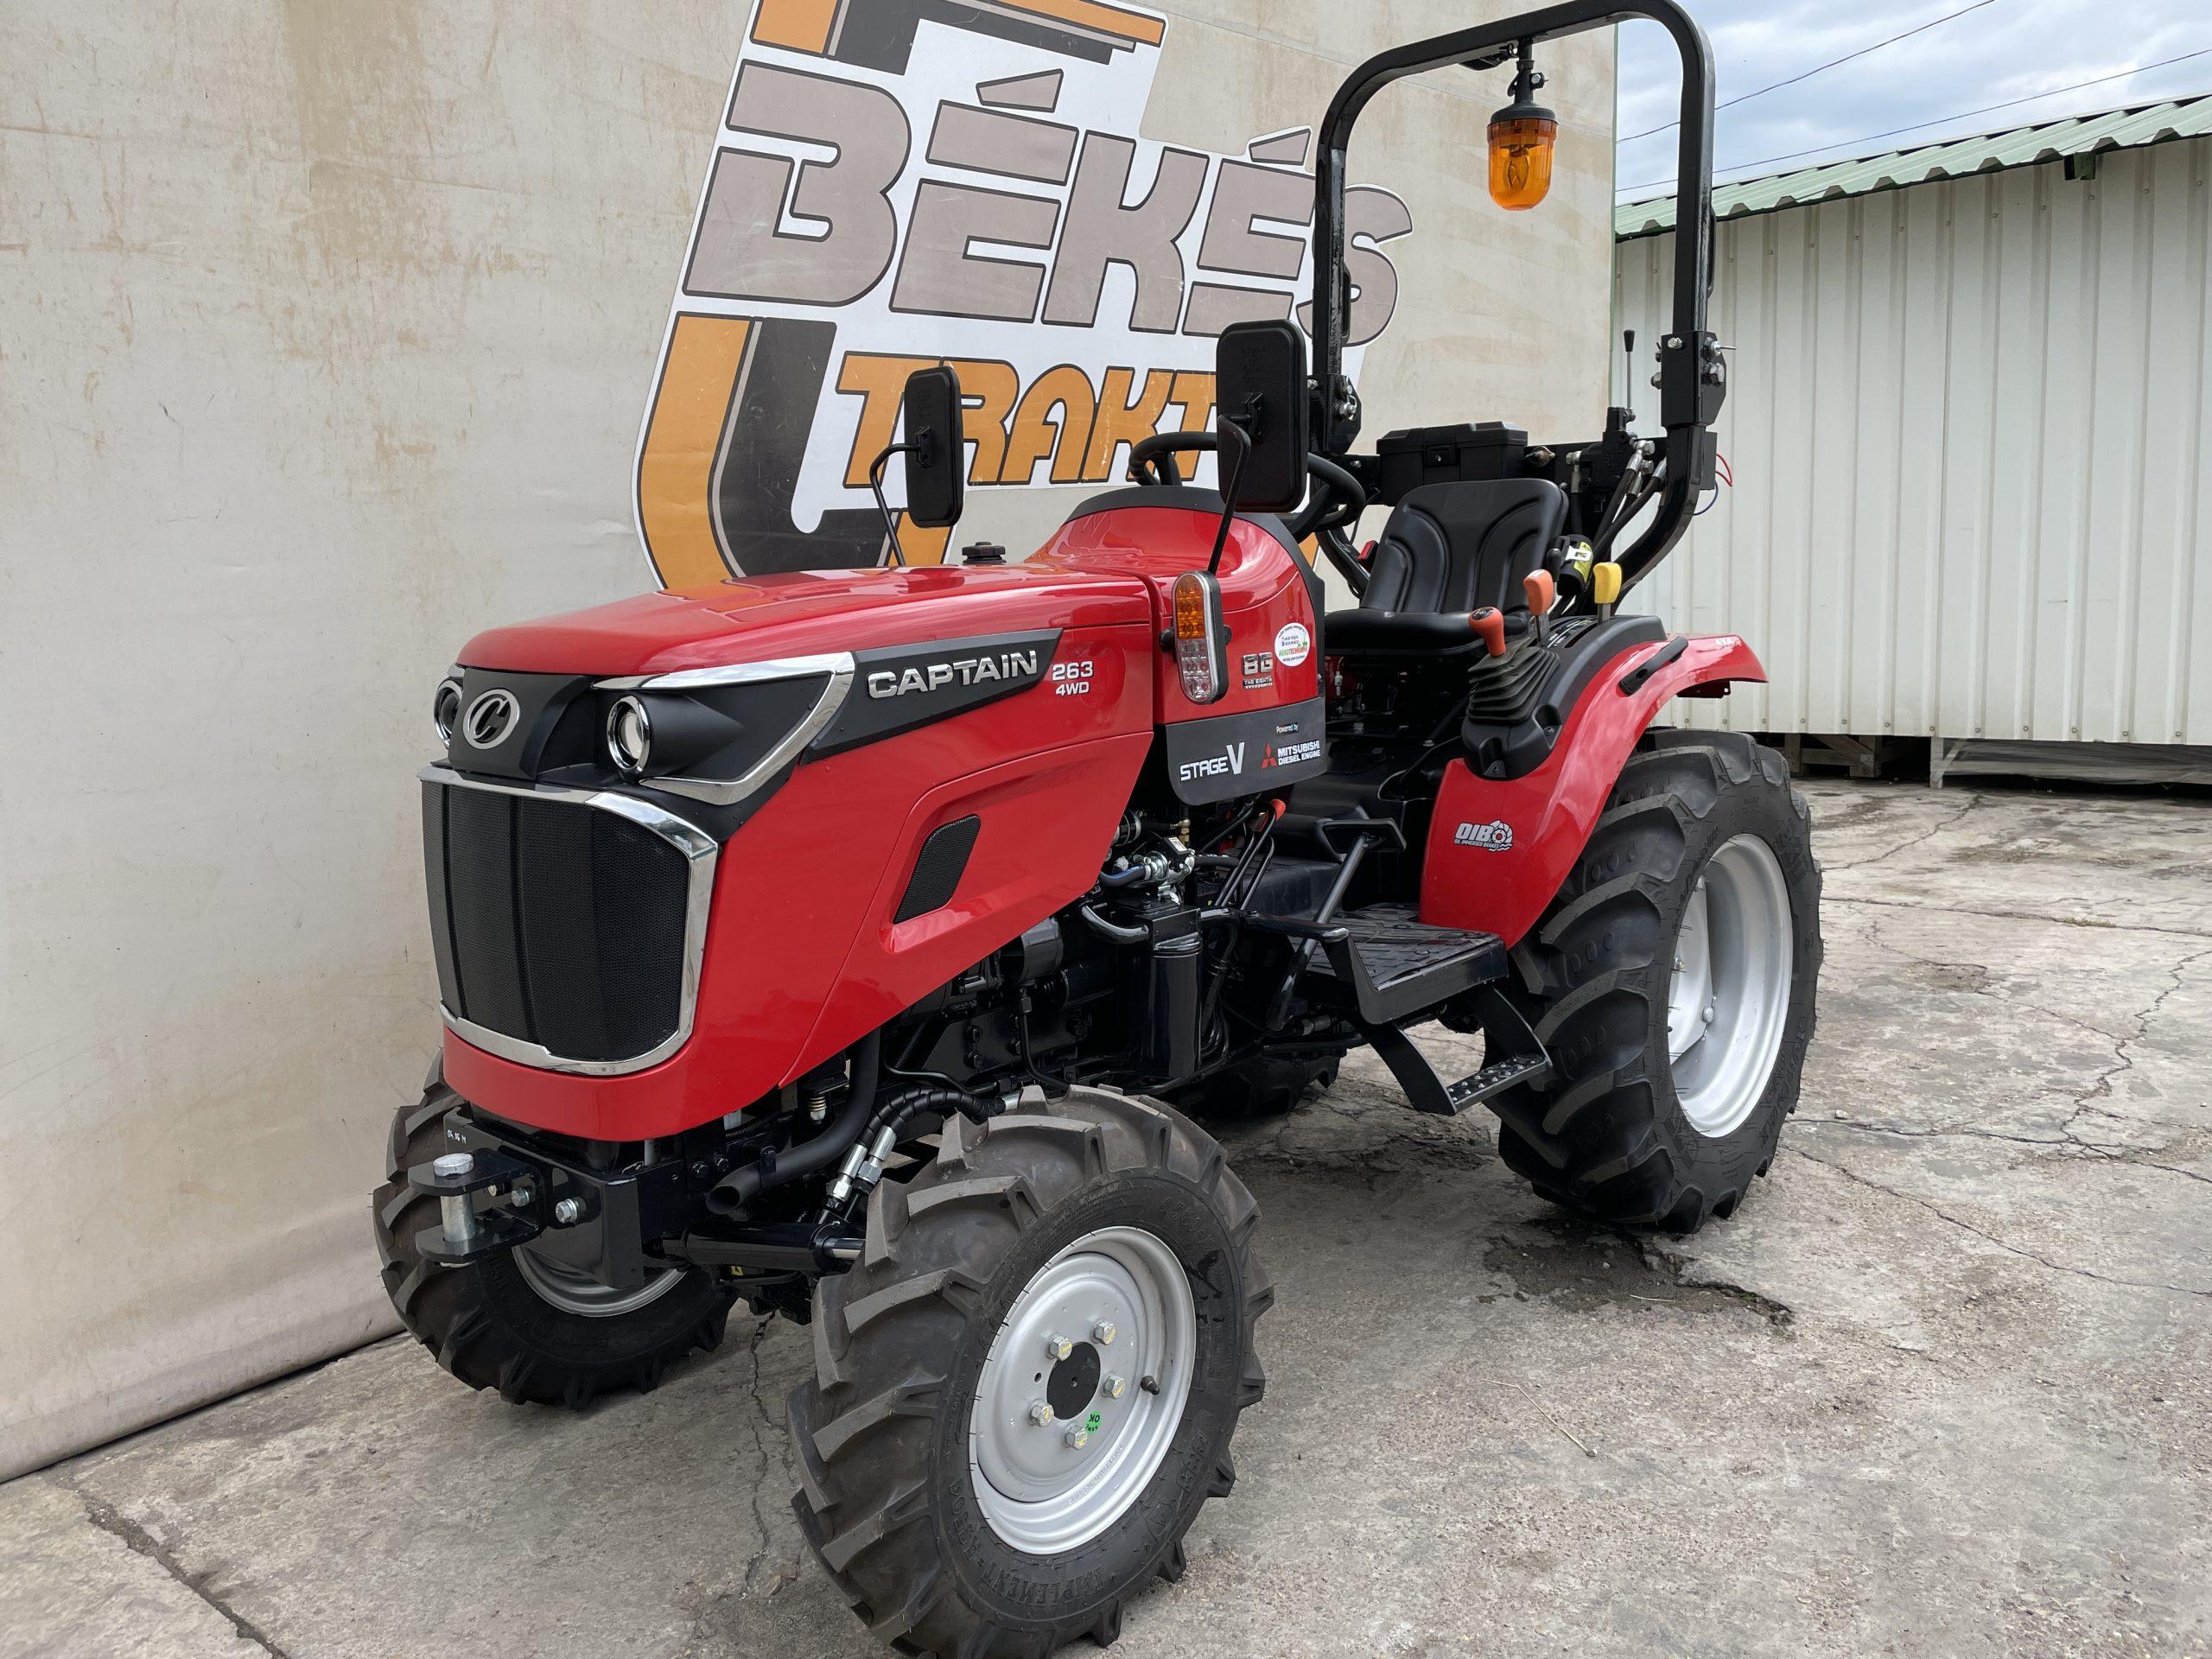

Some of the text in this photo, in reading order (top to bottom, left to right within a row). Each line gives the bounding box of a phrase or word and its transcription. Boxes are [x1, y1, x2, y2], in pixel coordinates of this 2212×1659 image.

[683, 59, 1413, 346] BÉKÉS
[1052, 660, 1094, 682] 263
[1243, 652, 1273, 676] 8G
[868, 650, 1038, 699] CAPTAIN
[1055, 681, 1090, 696] 4WD
[1276, 722, 1299, 734] Powered by
[1277, 741, 1320, 757] MITSUBISHI
[1278, 750, 1321, 766] DIESEL ENGINE
[1179, 741, 1245, 781] STAGE V
[1089, 1414, 1101, 1423] OK
